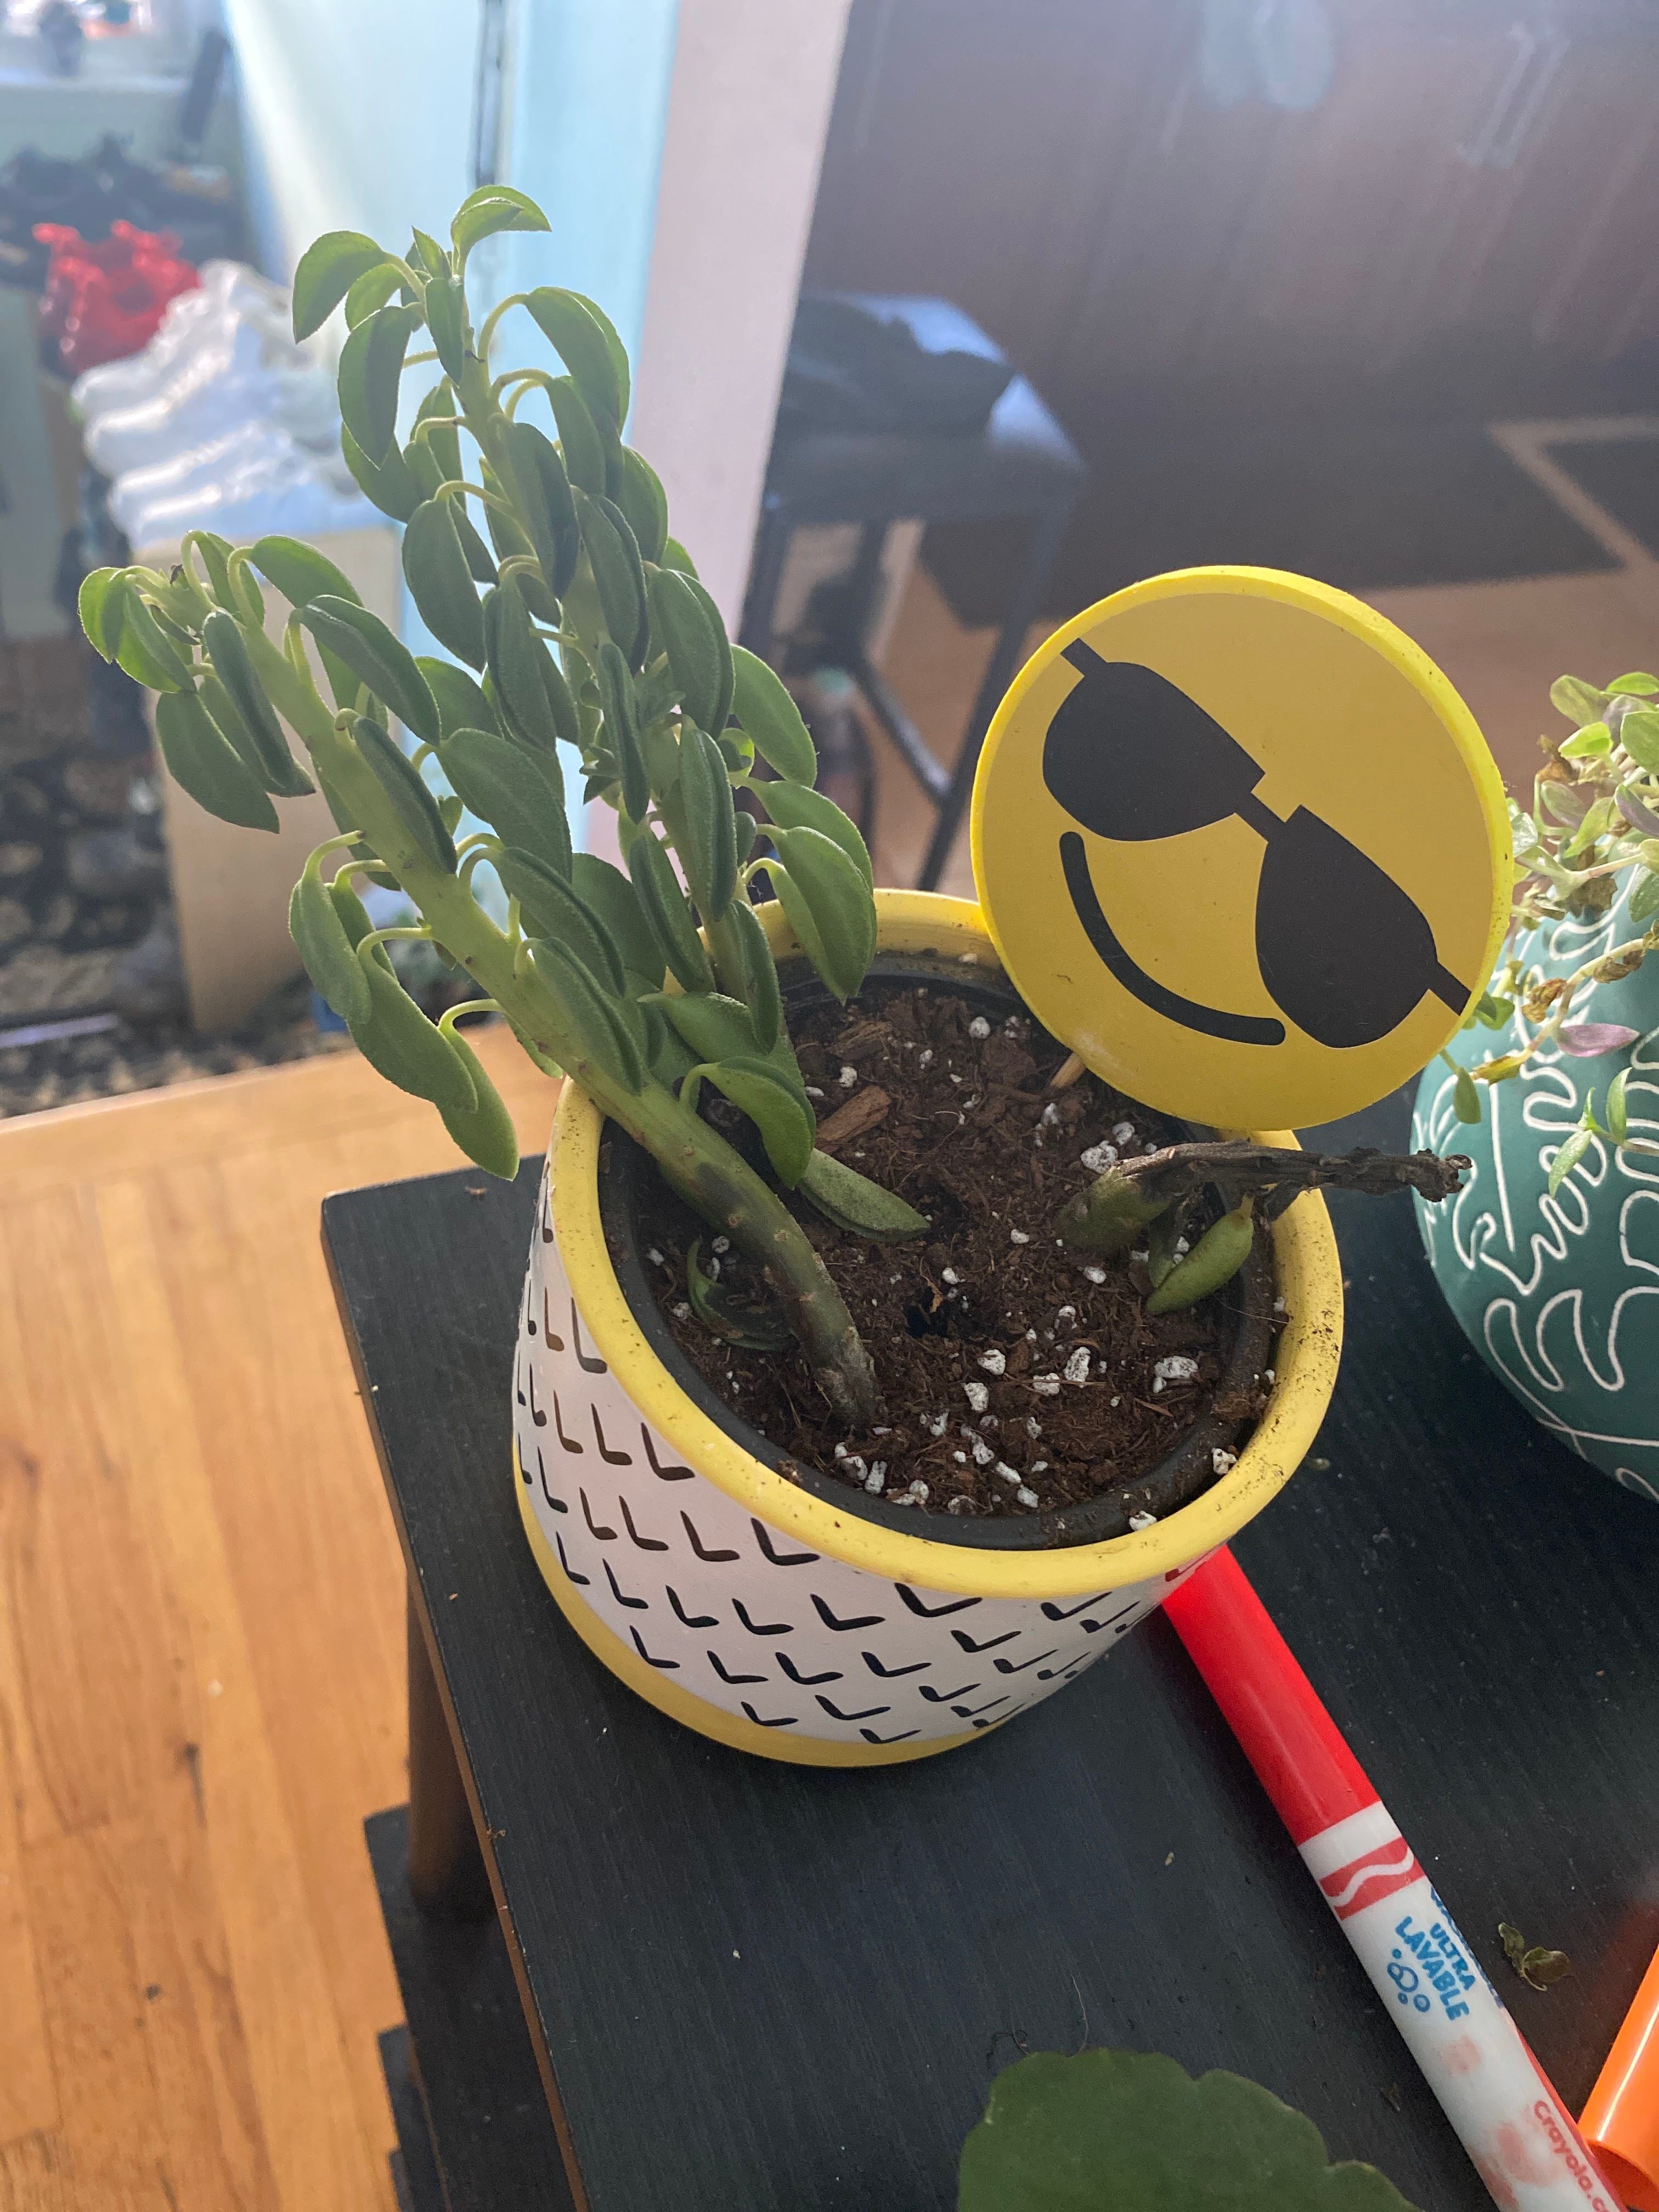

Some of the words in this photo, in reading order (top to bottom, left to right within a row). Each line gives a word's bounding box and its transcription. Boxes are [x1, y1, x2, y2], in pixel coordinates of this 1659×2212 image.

[1395, 1915, 1470, 2021] LAVABLE
[1430, 1922, 1476, 1991] ULTRA
[1533, 2100, 1612, 2212] Crayola.c
